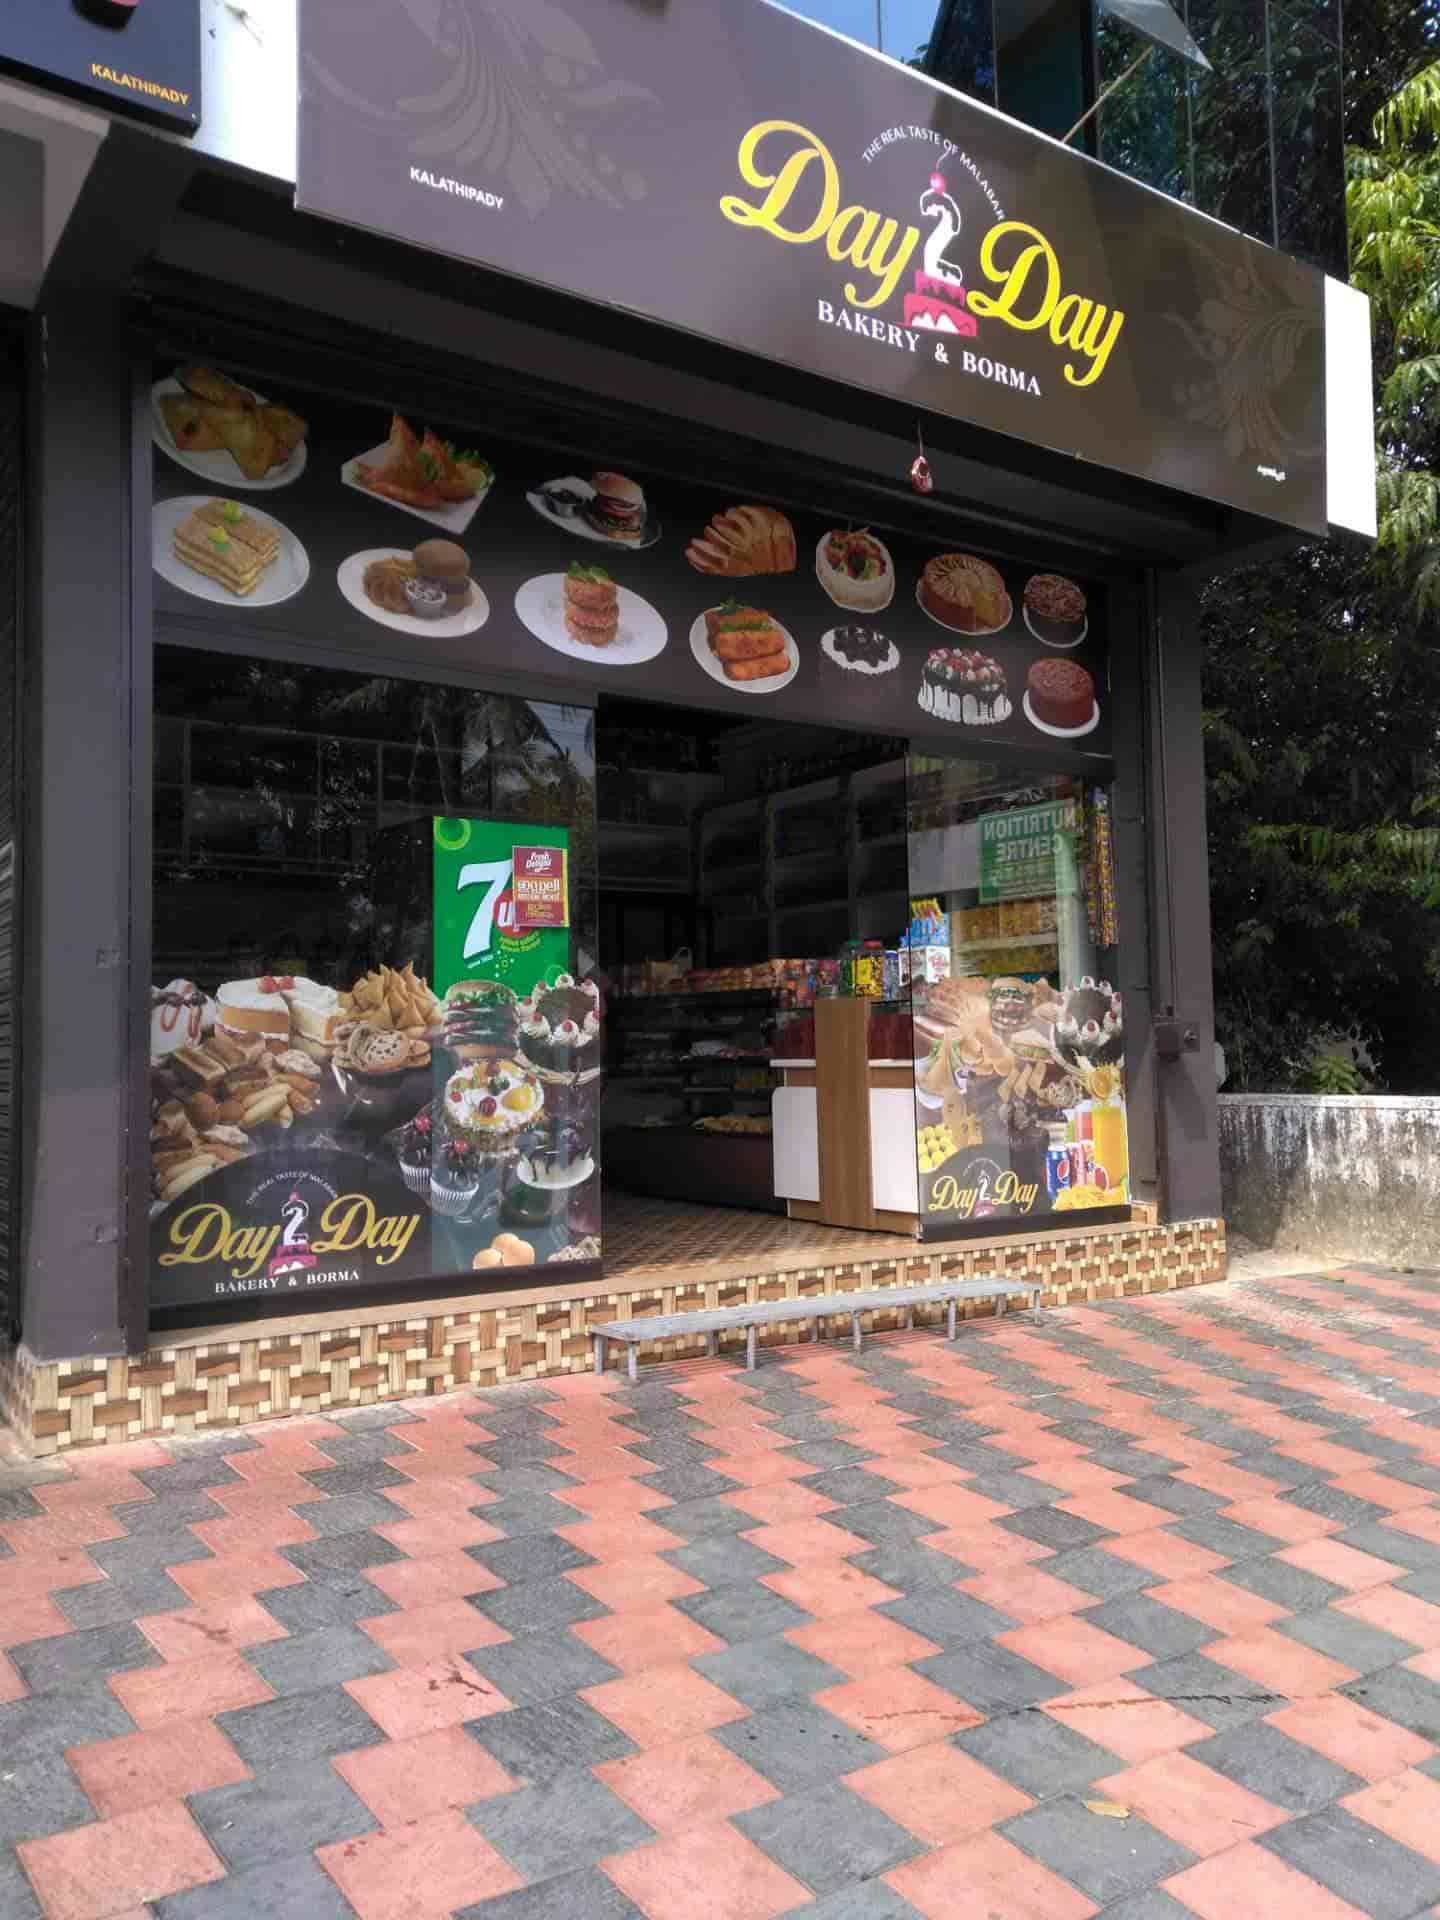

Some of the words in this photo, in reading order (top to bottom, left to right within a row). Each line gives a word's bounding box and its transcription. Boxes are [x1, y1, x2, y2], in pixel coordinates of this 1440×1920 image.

[91, 63, 191, 105] KALATHIPADY
[409, 166, 504, 209] KALATHIPADY
[861, 138, 883, 165] THE
[880, 127, 908, 145] REAL
[908, 125, 941, 145] TASTE
[943, 138, 960, 154] OF
[960, 152, 1006, 221] MALABAR
[720, 120, 920, 309] Day
[919, 189, 963, 288] 2
[966, 221, 1126, 387] Day
[818, 299, 920, 353] BAKERY
[934, 342, 950, 364] &
[962, 350, 1042, 396] BORMA
[928, 1175, 978, 1220] Day
[992, 1170, 1039, 1214] Day
[158, 1203, 281, 1279] Day
[281, 1199, 310, 1247] 2
[310, 1193, 421, 1265] Day
[215, 1276, 279, 1294] BAKERY
[288, 1276, 297, 1287] &
[307, 1270, 360, 1286] BORMA
